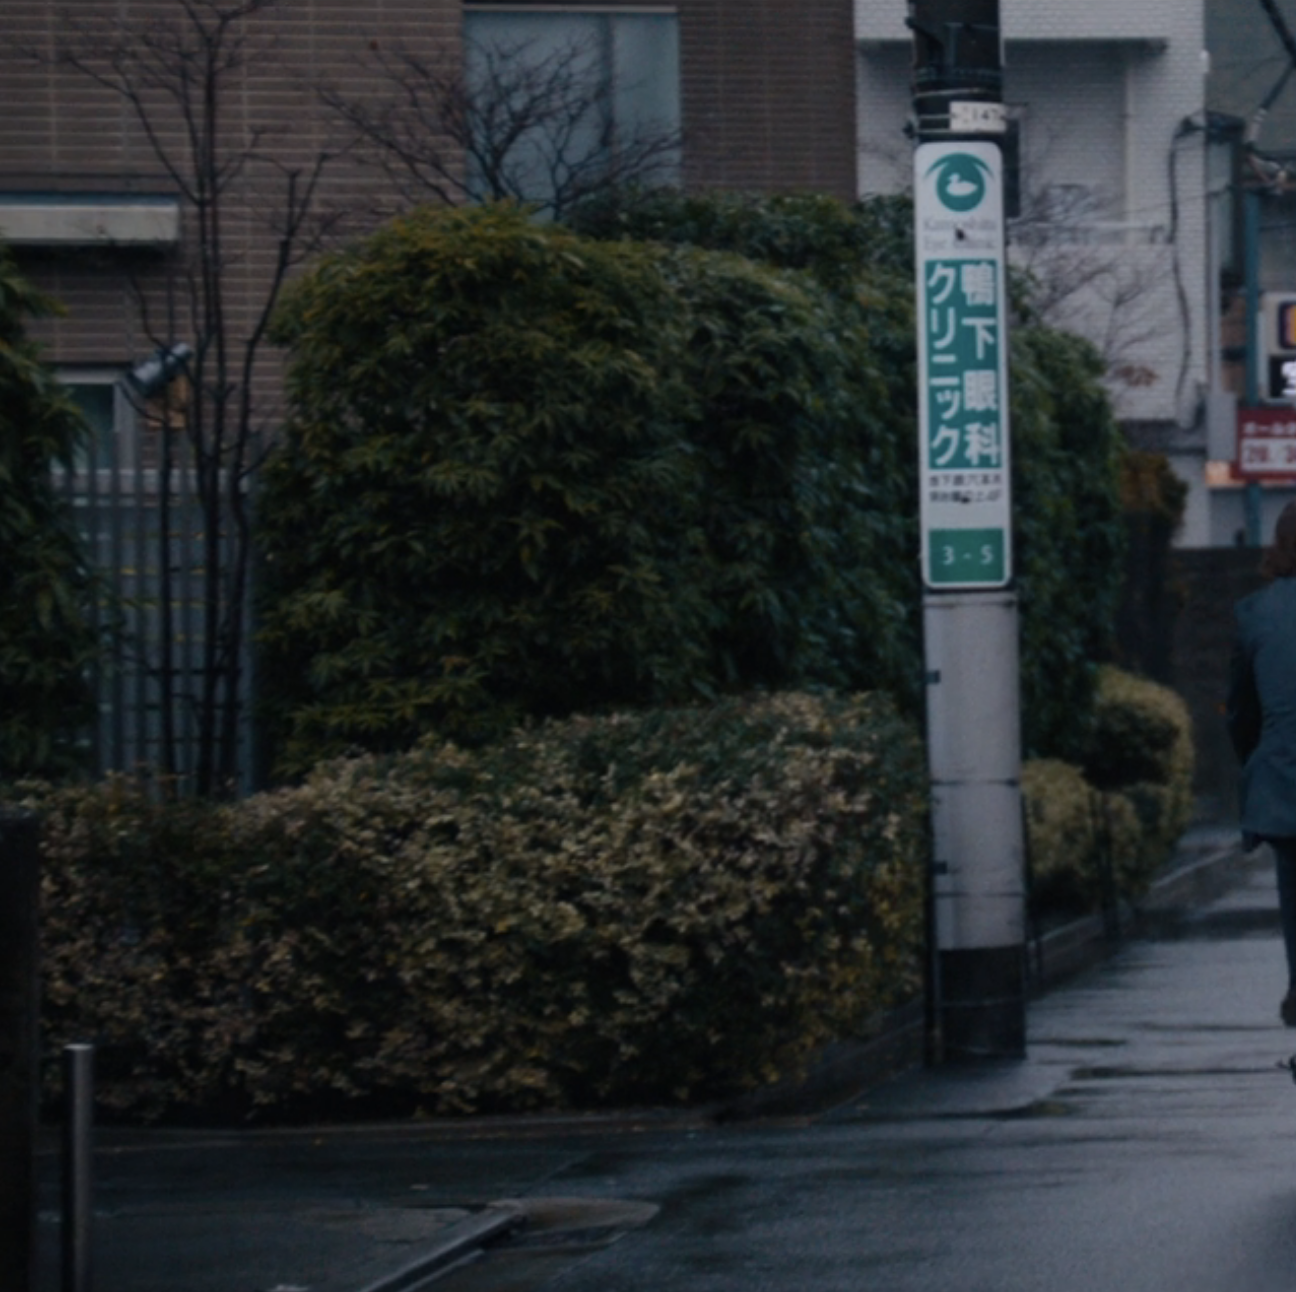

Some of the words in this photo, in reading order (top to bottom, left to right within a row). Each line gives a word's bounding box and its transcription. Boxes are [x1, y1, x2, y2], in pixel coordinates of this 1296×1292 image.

[927, 261, 960, 467] クリニック
[960, 261, 999, 467] 鴨下眼科
